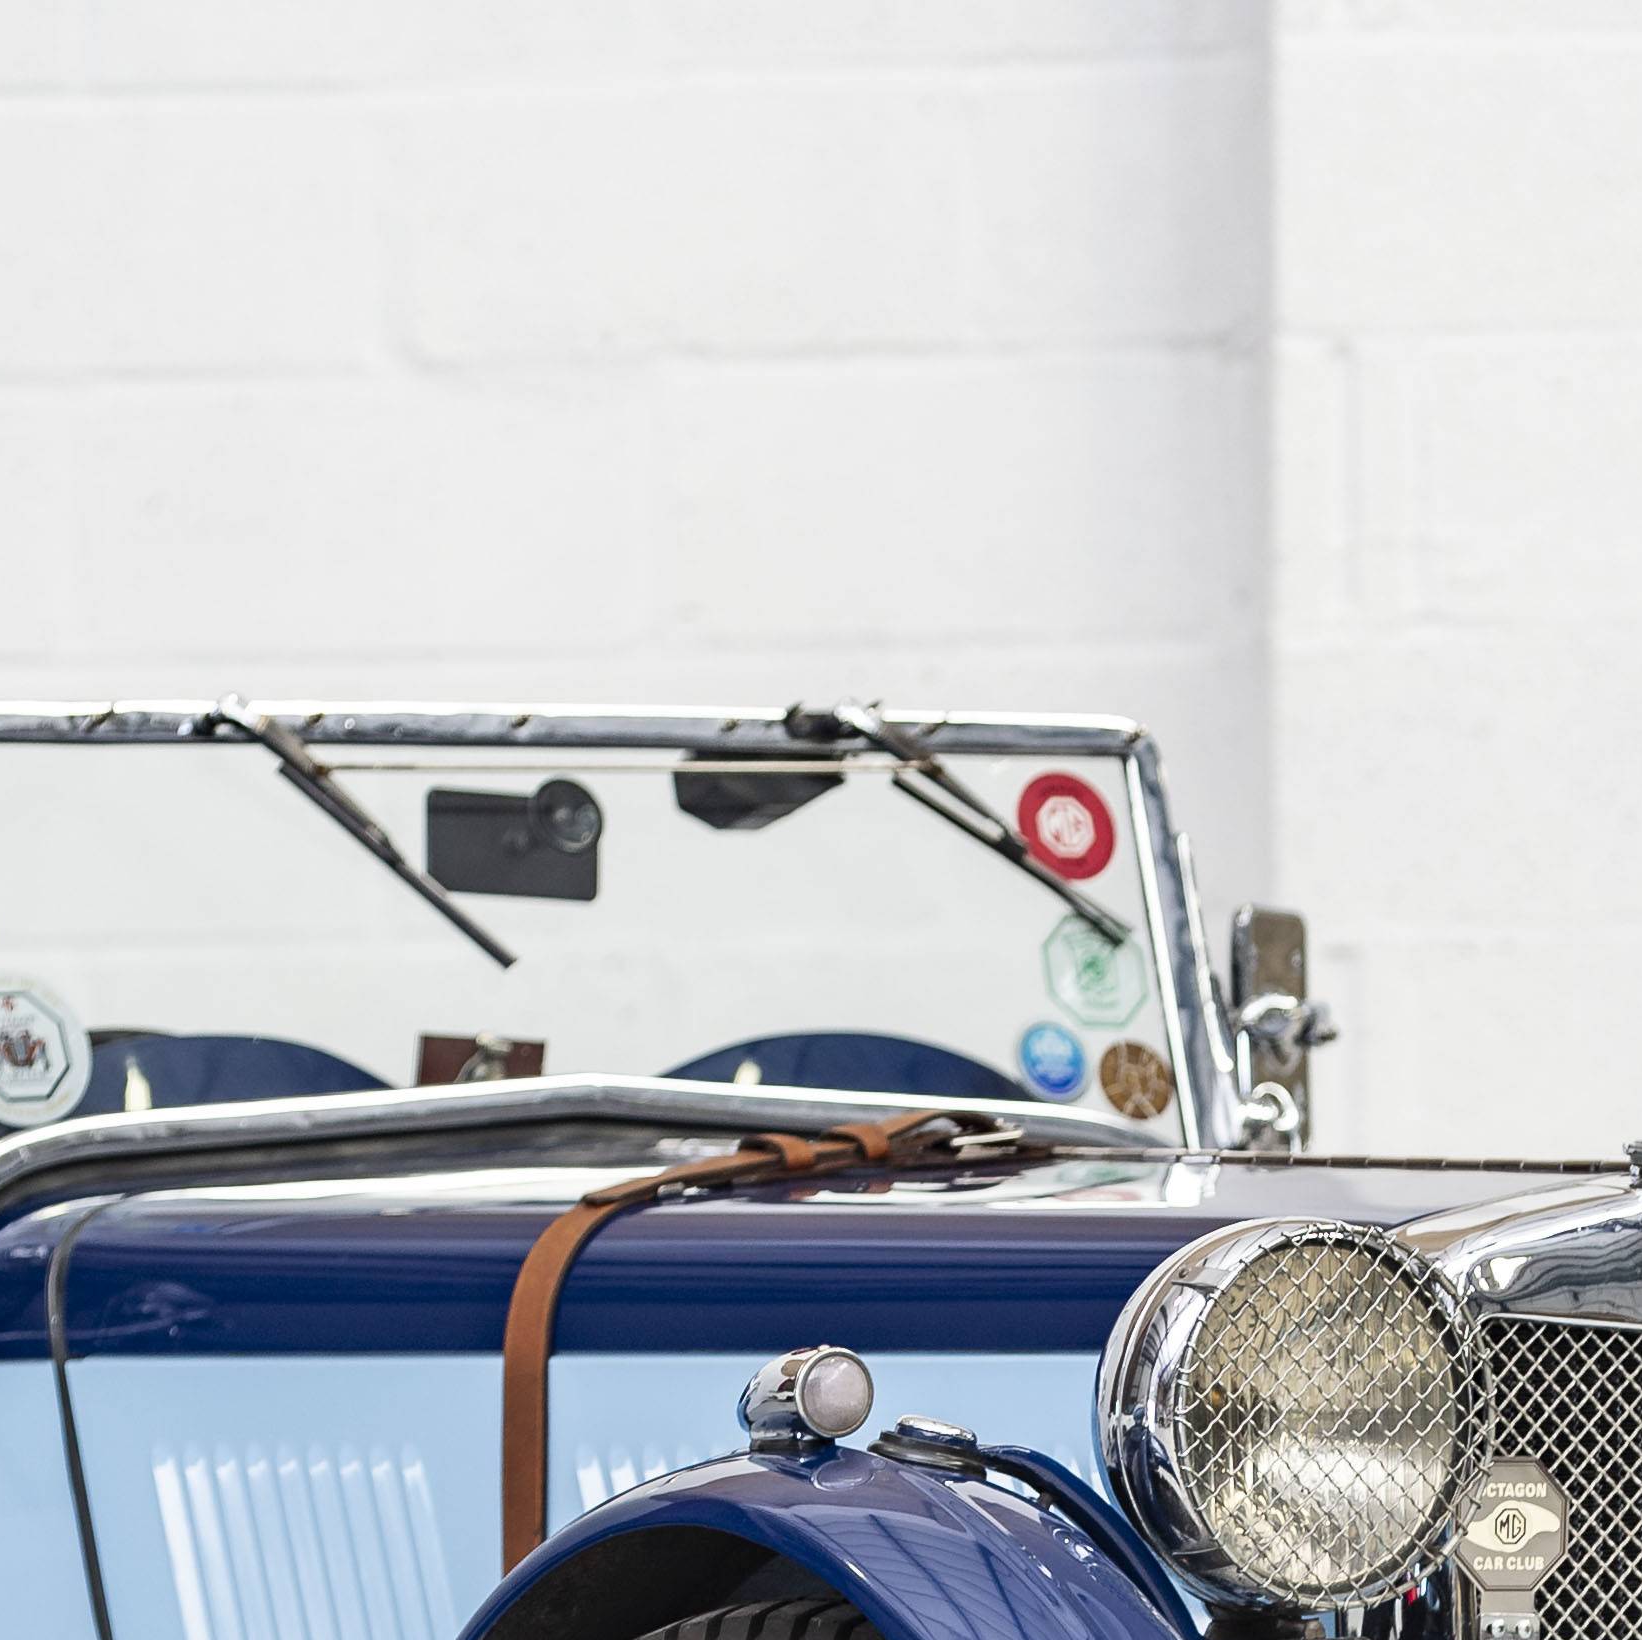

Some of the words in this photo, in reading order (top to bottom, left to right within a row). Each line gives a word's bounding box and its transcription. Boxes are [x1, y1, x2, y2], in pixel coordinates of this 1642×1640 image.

[1482, 1482, 1547, 1498] CTAGON
[1499, 1513, 1522, 1539] MG
[1473, 1556, 1504, 1571] CAR
[1506, 1556, 1545, 1571] CLUB
